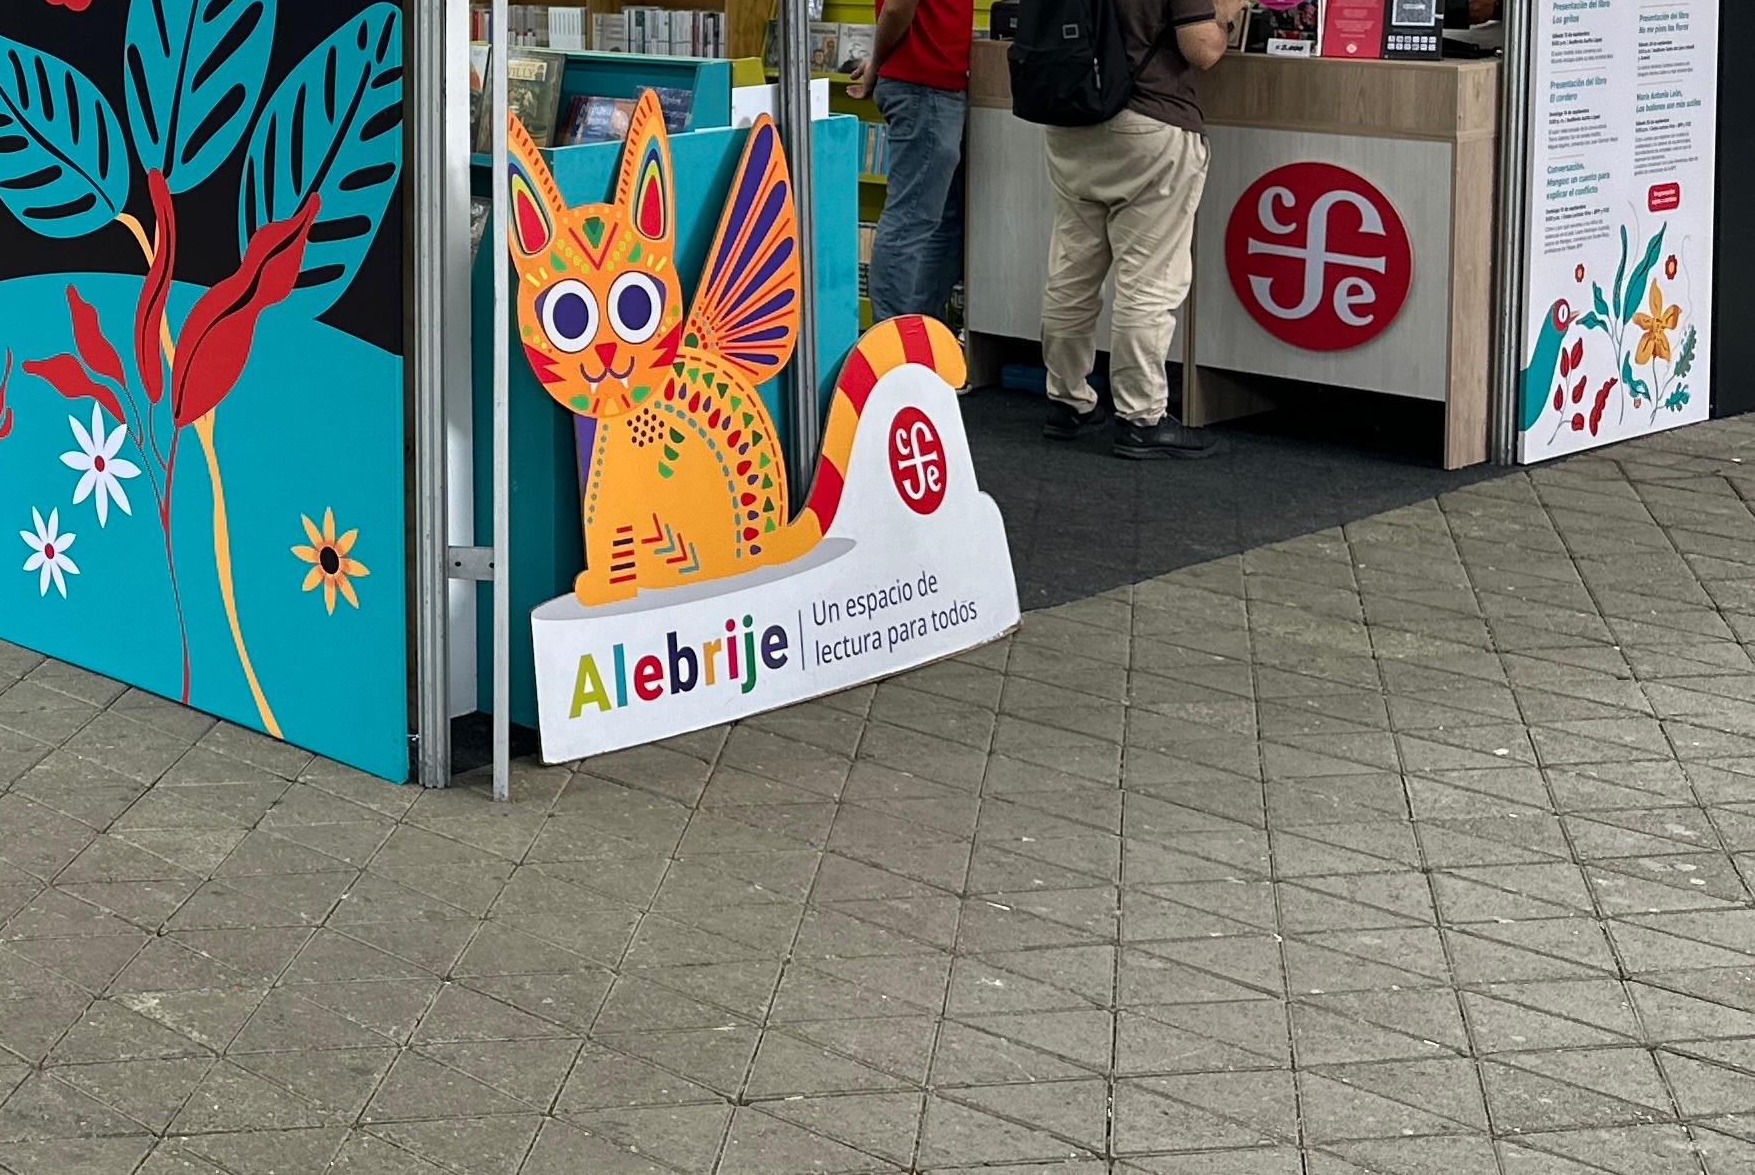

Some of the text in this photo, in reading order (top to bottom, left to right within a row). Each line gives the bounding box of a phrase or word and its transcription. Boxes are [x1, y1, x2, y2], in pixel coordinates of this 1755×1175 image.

[812, 571, 939, 627] Un espacio de
[815, 598, 978, 666] lectura para todos
[568, 614, 789, 719] Alebrije
